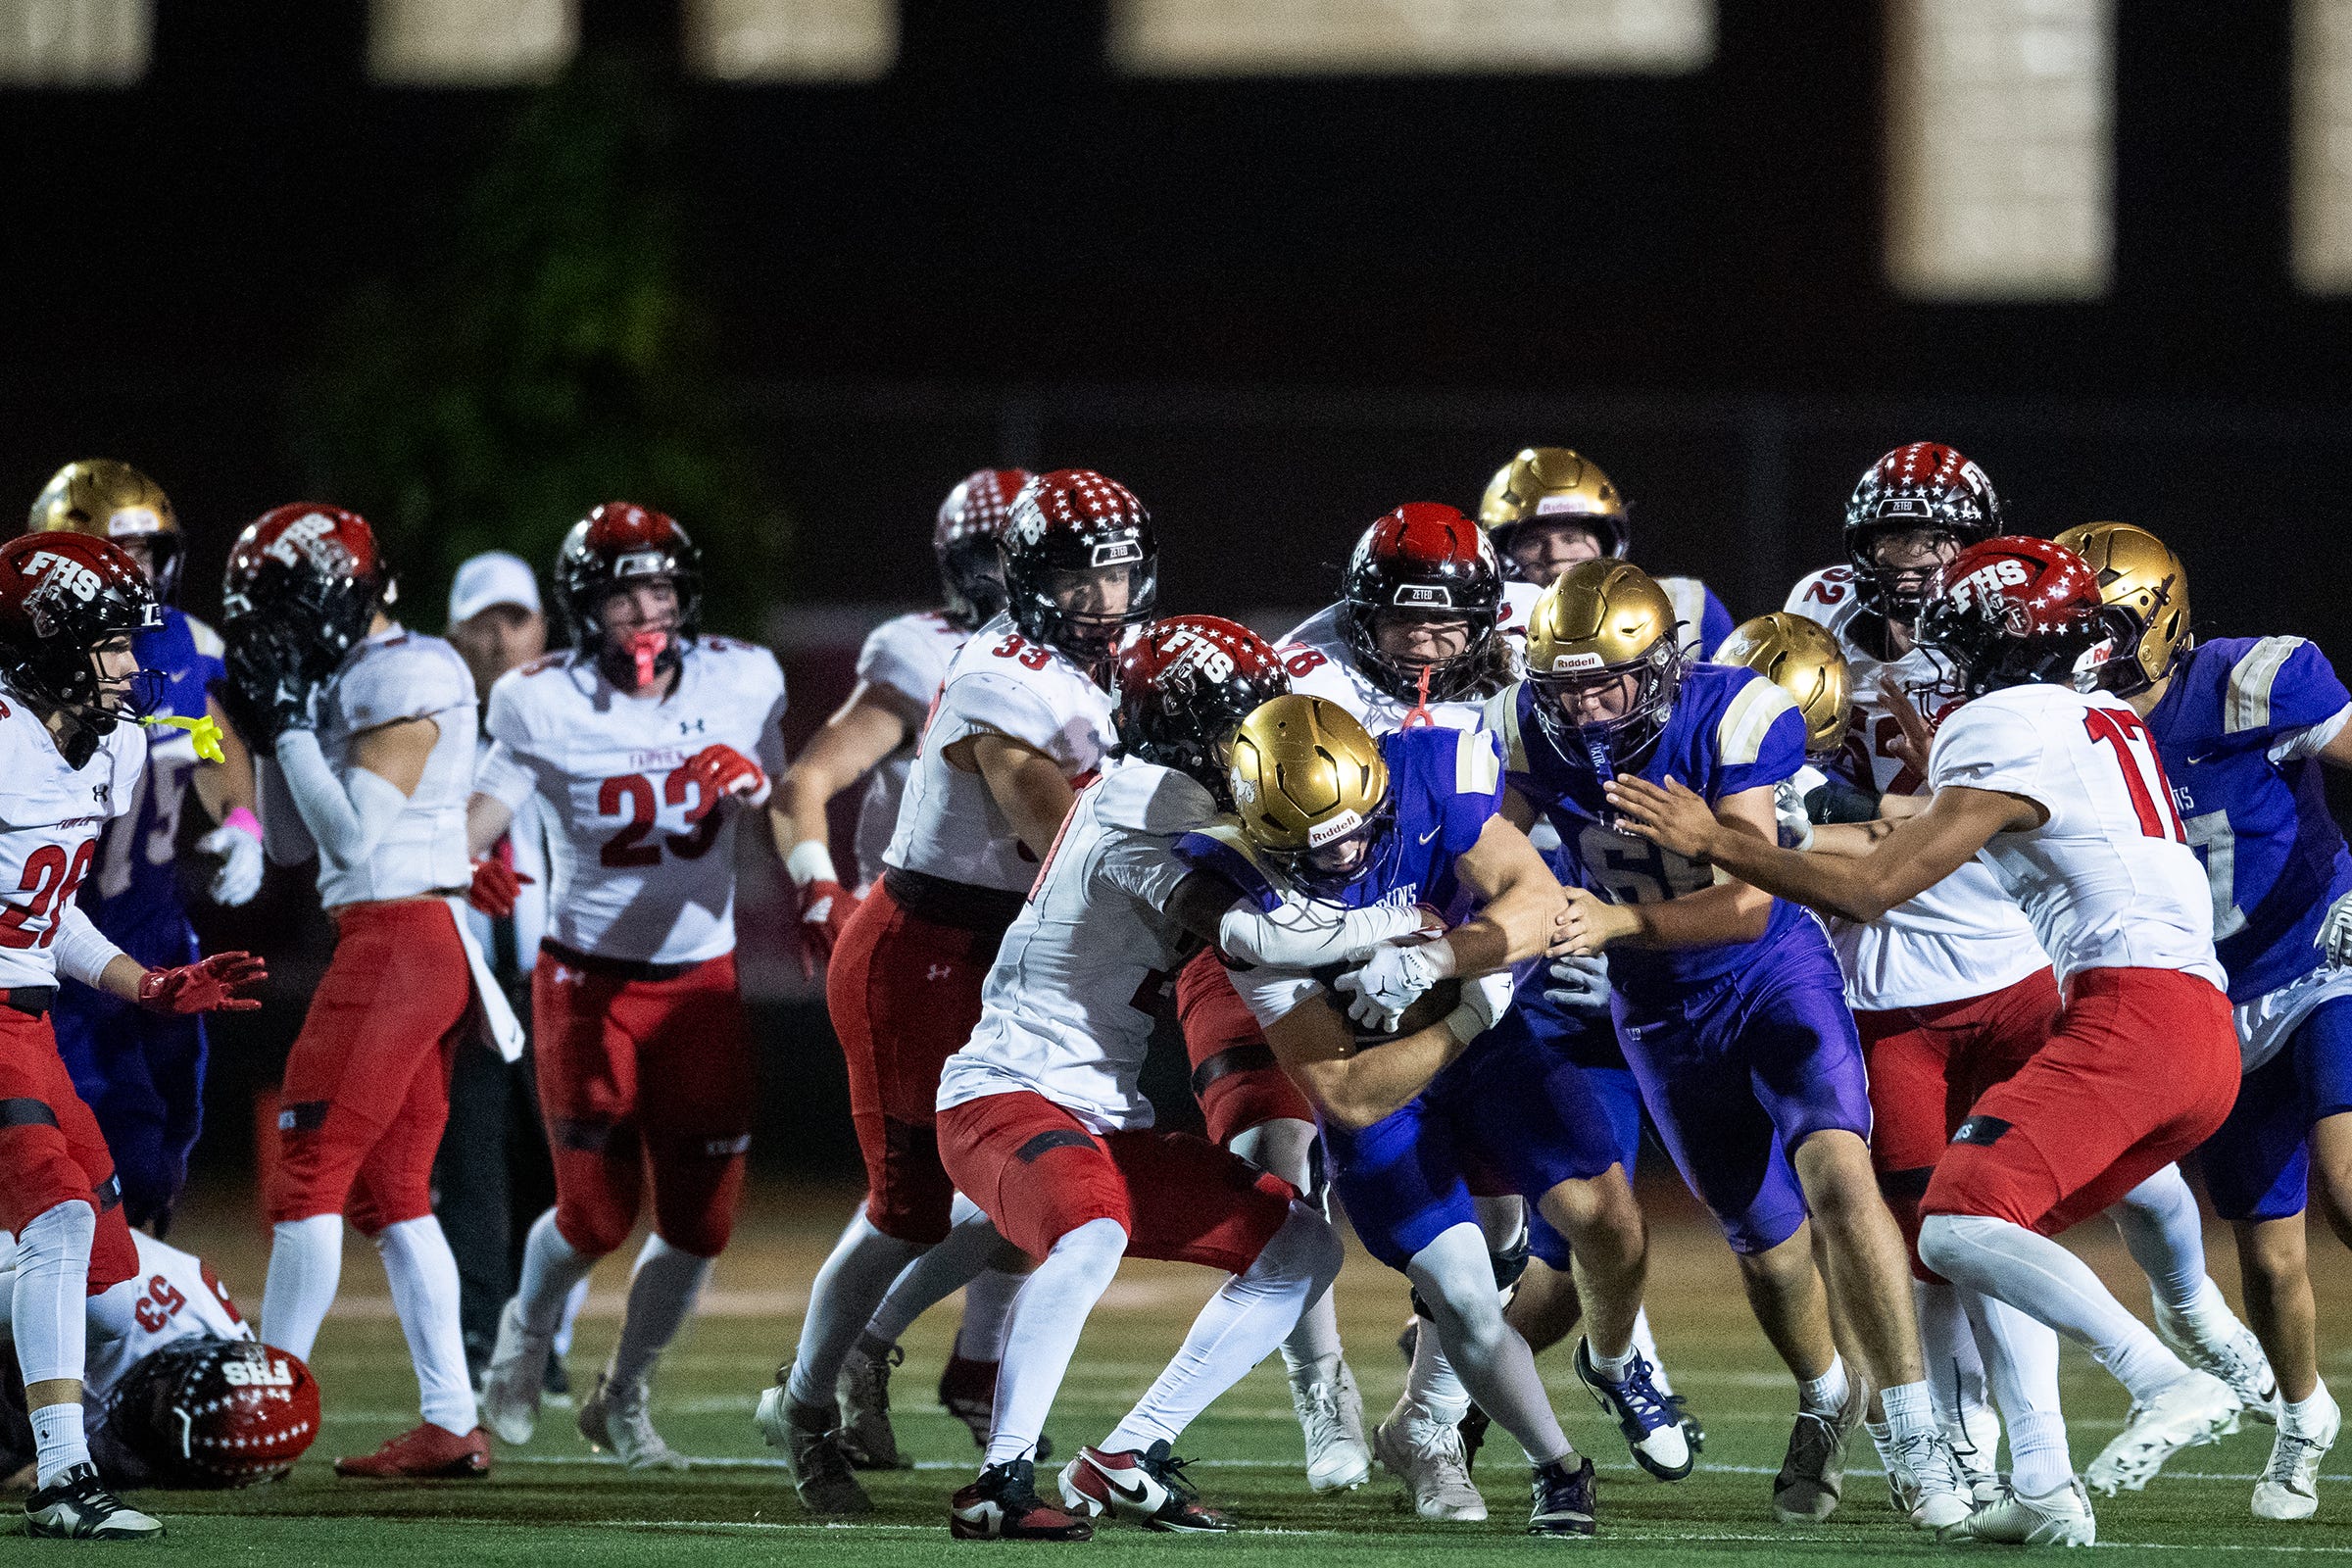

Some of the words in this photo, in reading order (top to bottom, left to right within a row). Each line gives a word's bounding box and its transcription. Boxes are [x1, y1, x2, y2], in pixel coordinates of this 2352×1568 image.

[263, 513, 336, 567] FHS
[22, 551, 102, 602] FHS
[1949, 560, 2028, 615] FHS
[992, 634, 1052, 671] 33
[1160, 630, 1235, 684] FHS
[1557, 657, 1595, 668] Riddell
[2082, 706, 2187, 846] 17
[597, 771, 725, 869] 23
[1312, 815, 1356, 843] Riddell
[221, 1359, 294, 1387] FHS
